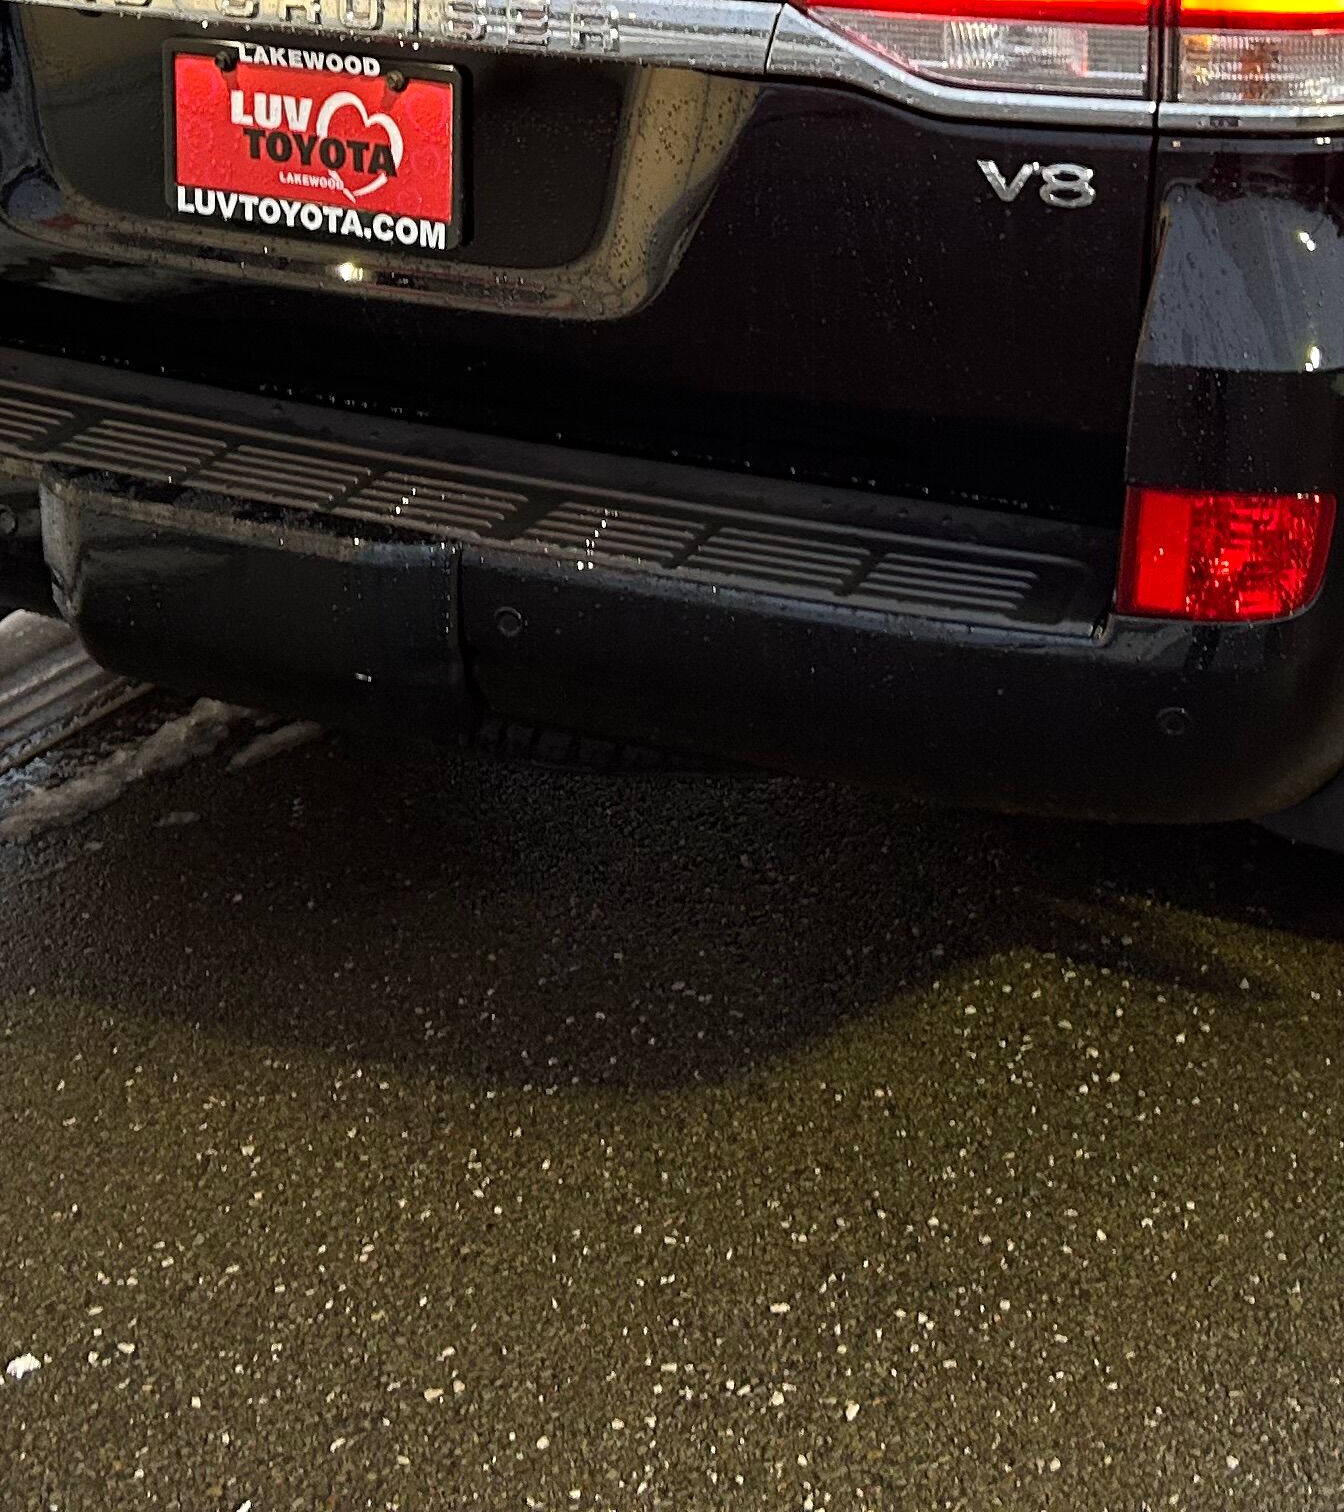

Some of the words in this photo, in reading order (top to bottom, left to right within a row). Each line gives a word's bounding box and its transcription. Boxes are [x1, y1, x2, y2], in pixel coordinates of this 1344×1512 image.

[238, 45, 381, 77] LAKEWOOD
[230, 89, 313, 132] LUV
[243, 127, 398, 178] TOYOTA
[278, 170, 345, 192] LAKEWOOD
[975, 159, 1097, 209] V8
[176, 185, 447, 251] LUVTOYOTA.COM
